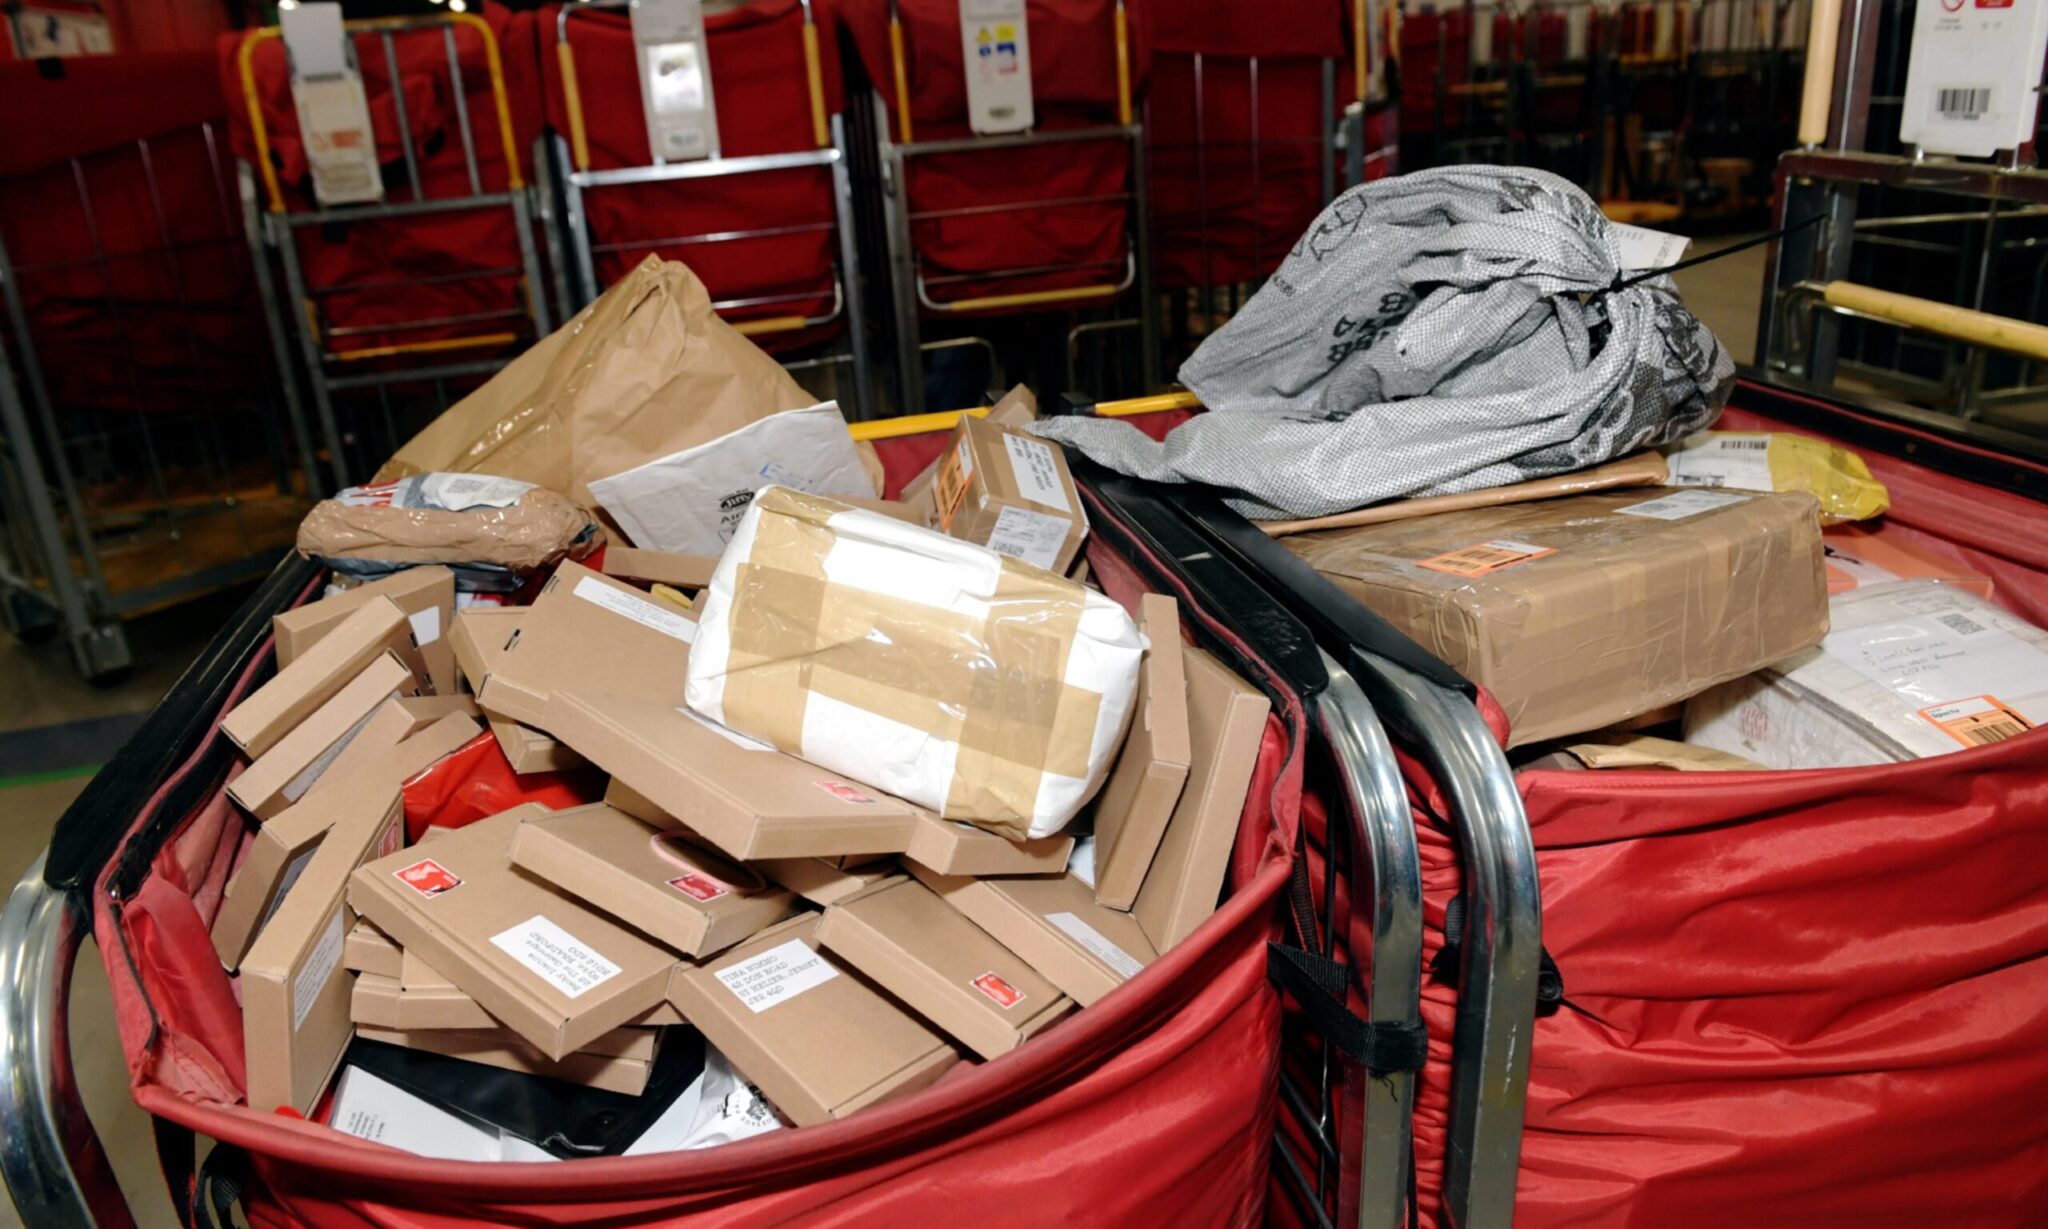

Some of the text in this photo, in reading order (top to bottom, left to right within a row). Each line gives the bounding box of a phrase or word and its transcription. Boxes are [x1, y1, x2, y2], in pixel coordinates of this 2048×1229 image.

[528, 932, 575, 964] BRADFORD
[721, 955, 778, 983] TINA NIMMO
[764, 961, 789, 976] ROAD
[787, 957, 820, 977] JERSEY
